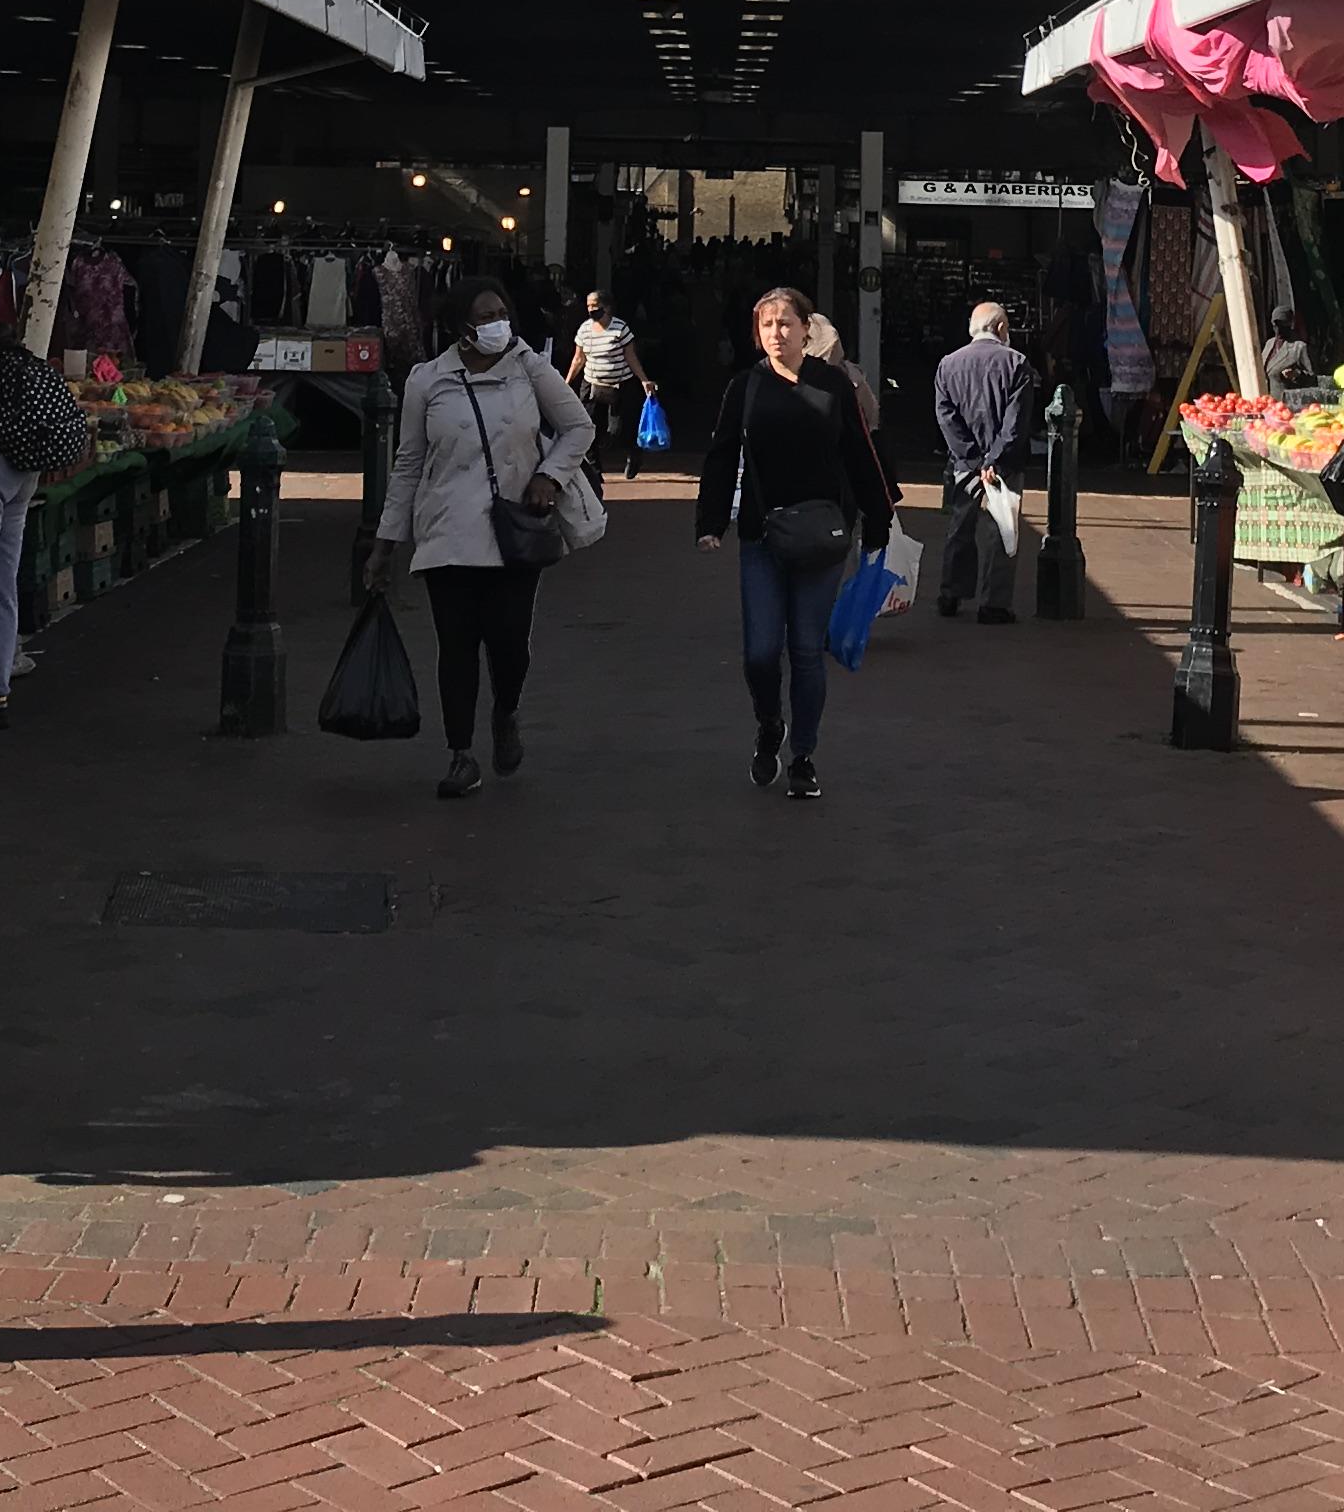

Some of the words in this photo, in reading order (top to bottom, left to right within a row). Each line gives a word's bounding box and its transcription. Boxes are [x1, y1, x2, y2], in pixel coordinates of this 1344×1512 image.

[922, 182, 937, 193] G
[944, 183, 957, 194] &
[964, 183, 977, 194] A
